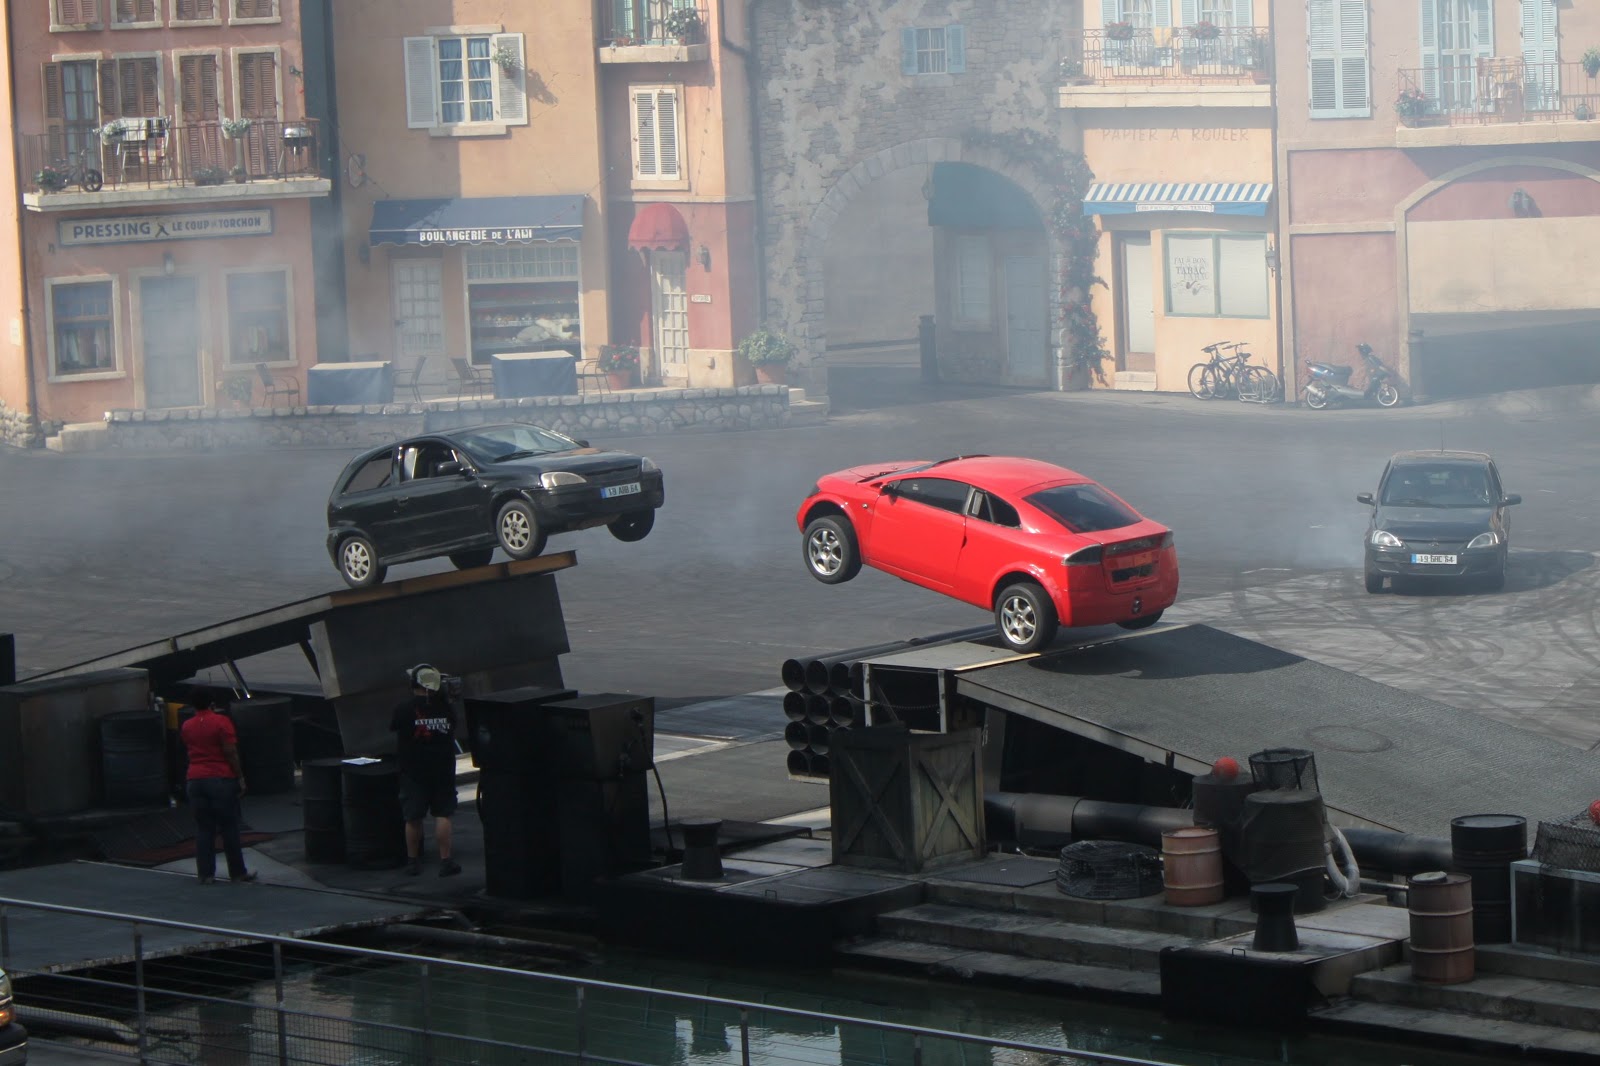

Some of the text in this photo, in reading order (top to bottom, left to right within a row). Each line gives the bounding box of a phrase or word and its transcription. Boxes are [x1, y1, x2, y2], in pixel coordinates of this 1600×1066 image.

[1102, 127, 1159, 142] PAPIER
[1191, 127, 1249, 142] ROULER
[73, 221, 151, 239] PRESSING
[172, 221, 183, 232] LE
[185, 219, 210, 231] COUP
[218, 216, 262, 229] TORCHON
[419, 228, 488, 242] BOULANGERIE
[1175, 266, 1205, 275] TABAC
[414, 717, 448, 726] EXTREME
[426, 723, 451, 731] STUNT
